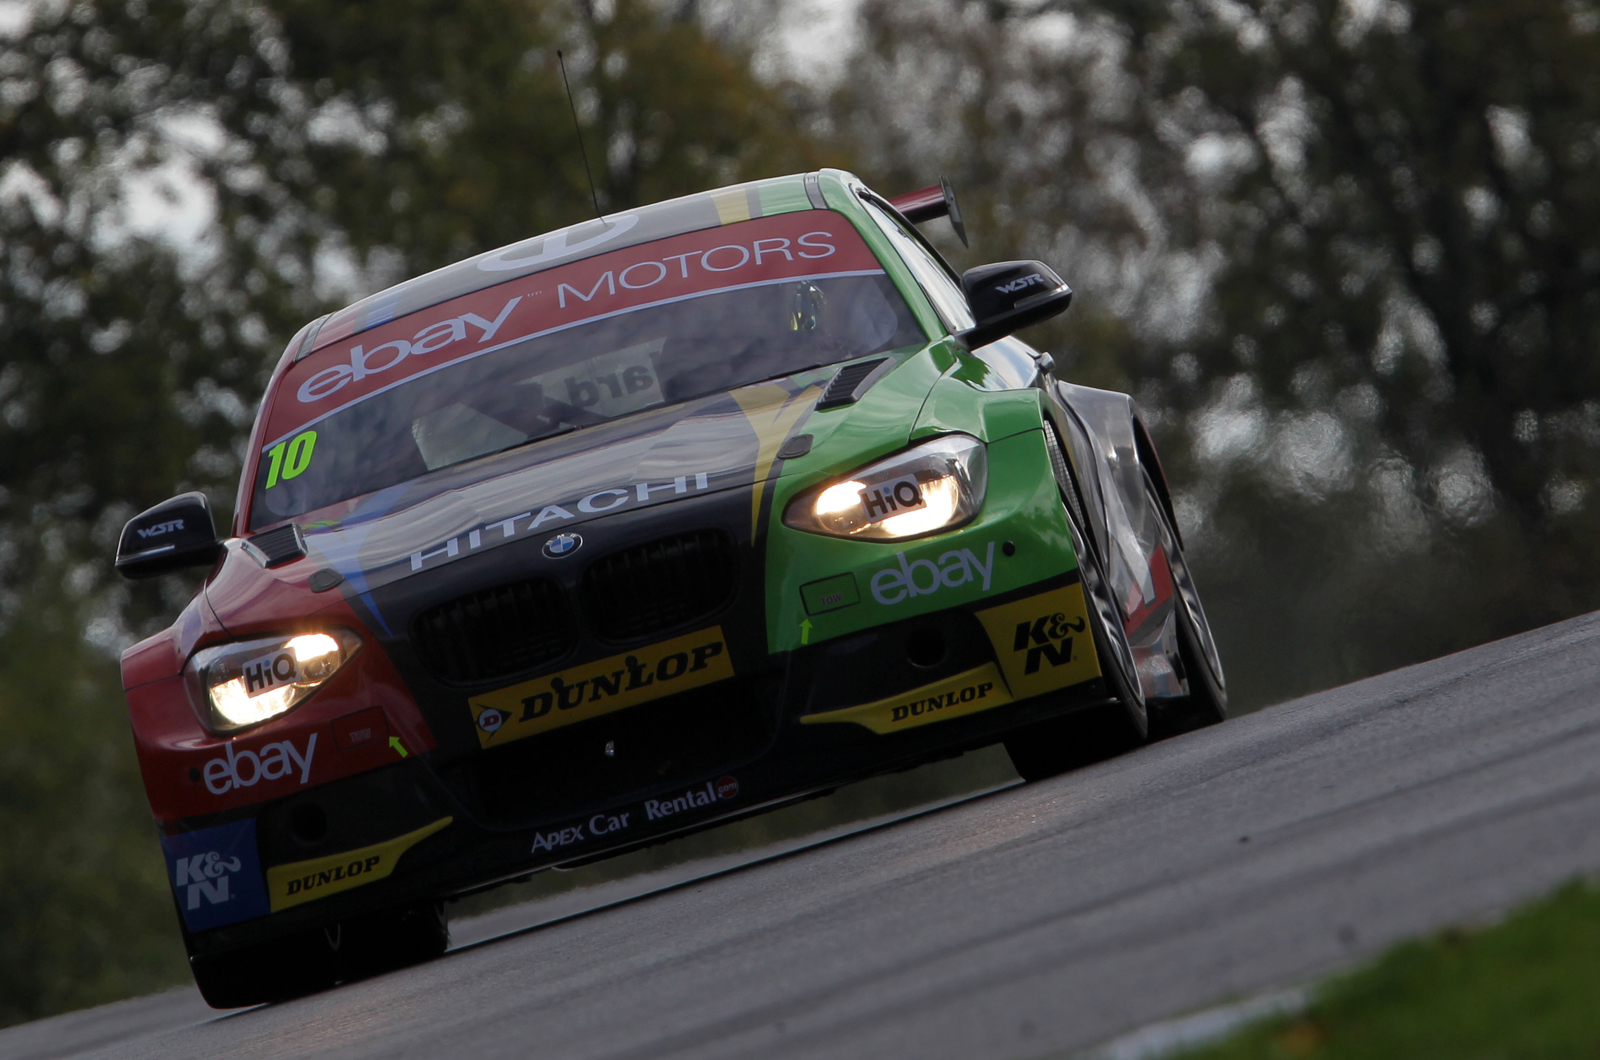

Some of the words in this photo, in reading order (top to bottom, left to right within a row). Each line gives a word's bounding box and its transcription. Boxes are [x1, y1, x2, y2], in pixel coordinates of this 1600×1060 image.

[995, 274, 1044, 293] WSR
[296, 297, 523, 402] ebay
[557, 231, 836, 308] MOTORS
[265, 430, 317, 489] 10
[861, 481, 922, 518] HiQ
[410, 472, 708, 571] HITACHI
[870, 541, 995, 605] ebay
[820, 593, 842, 606] TOW
[245, 653, 297, 693] HiQ
[519, 642, 723, 723] DUNLOP
[891, 682, 993, 722] DUNLOP
[203, 733, 318, 795] ebay
[589, 812, 630, 835] Car
[286, 855, 380, 895] DUNLOP
